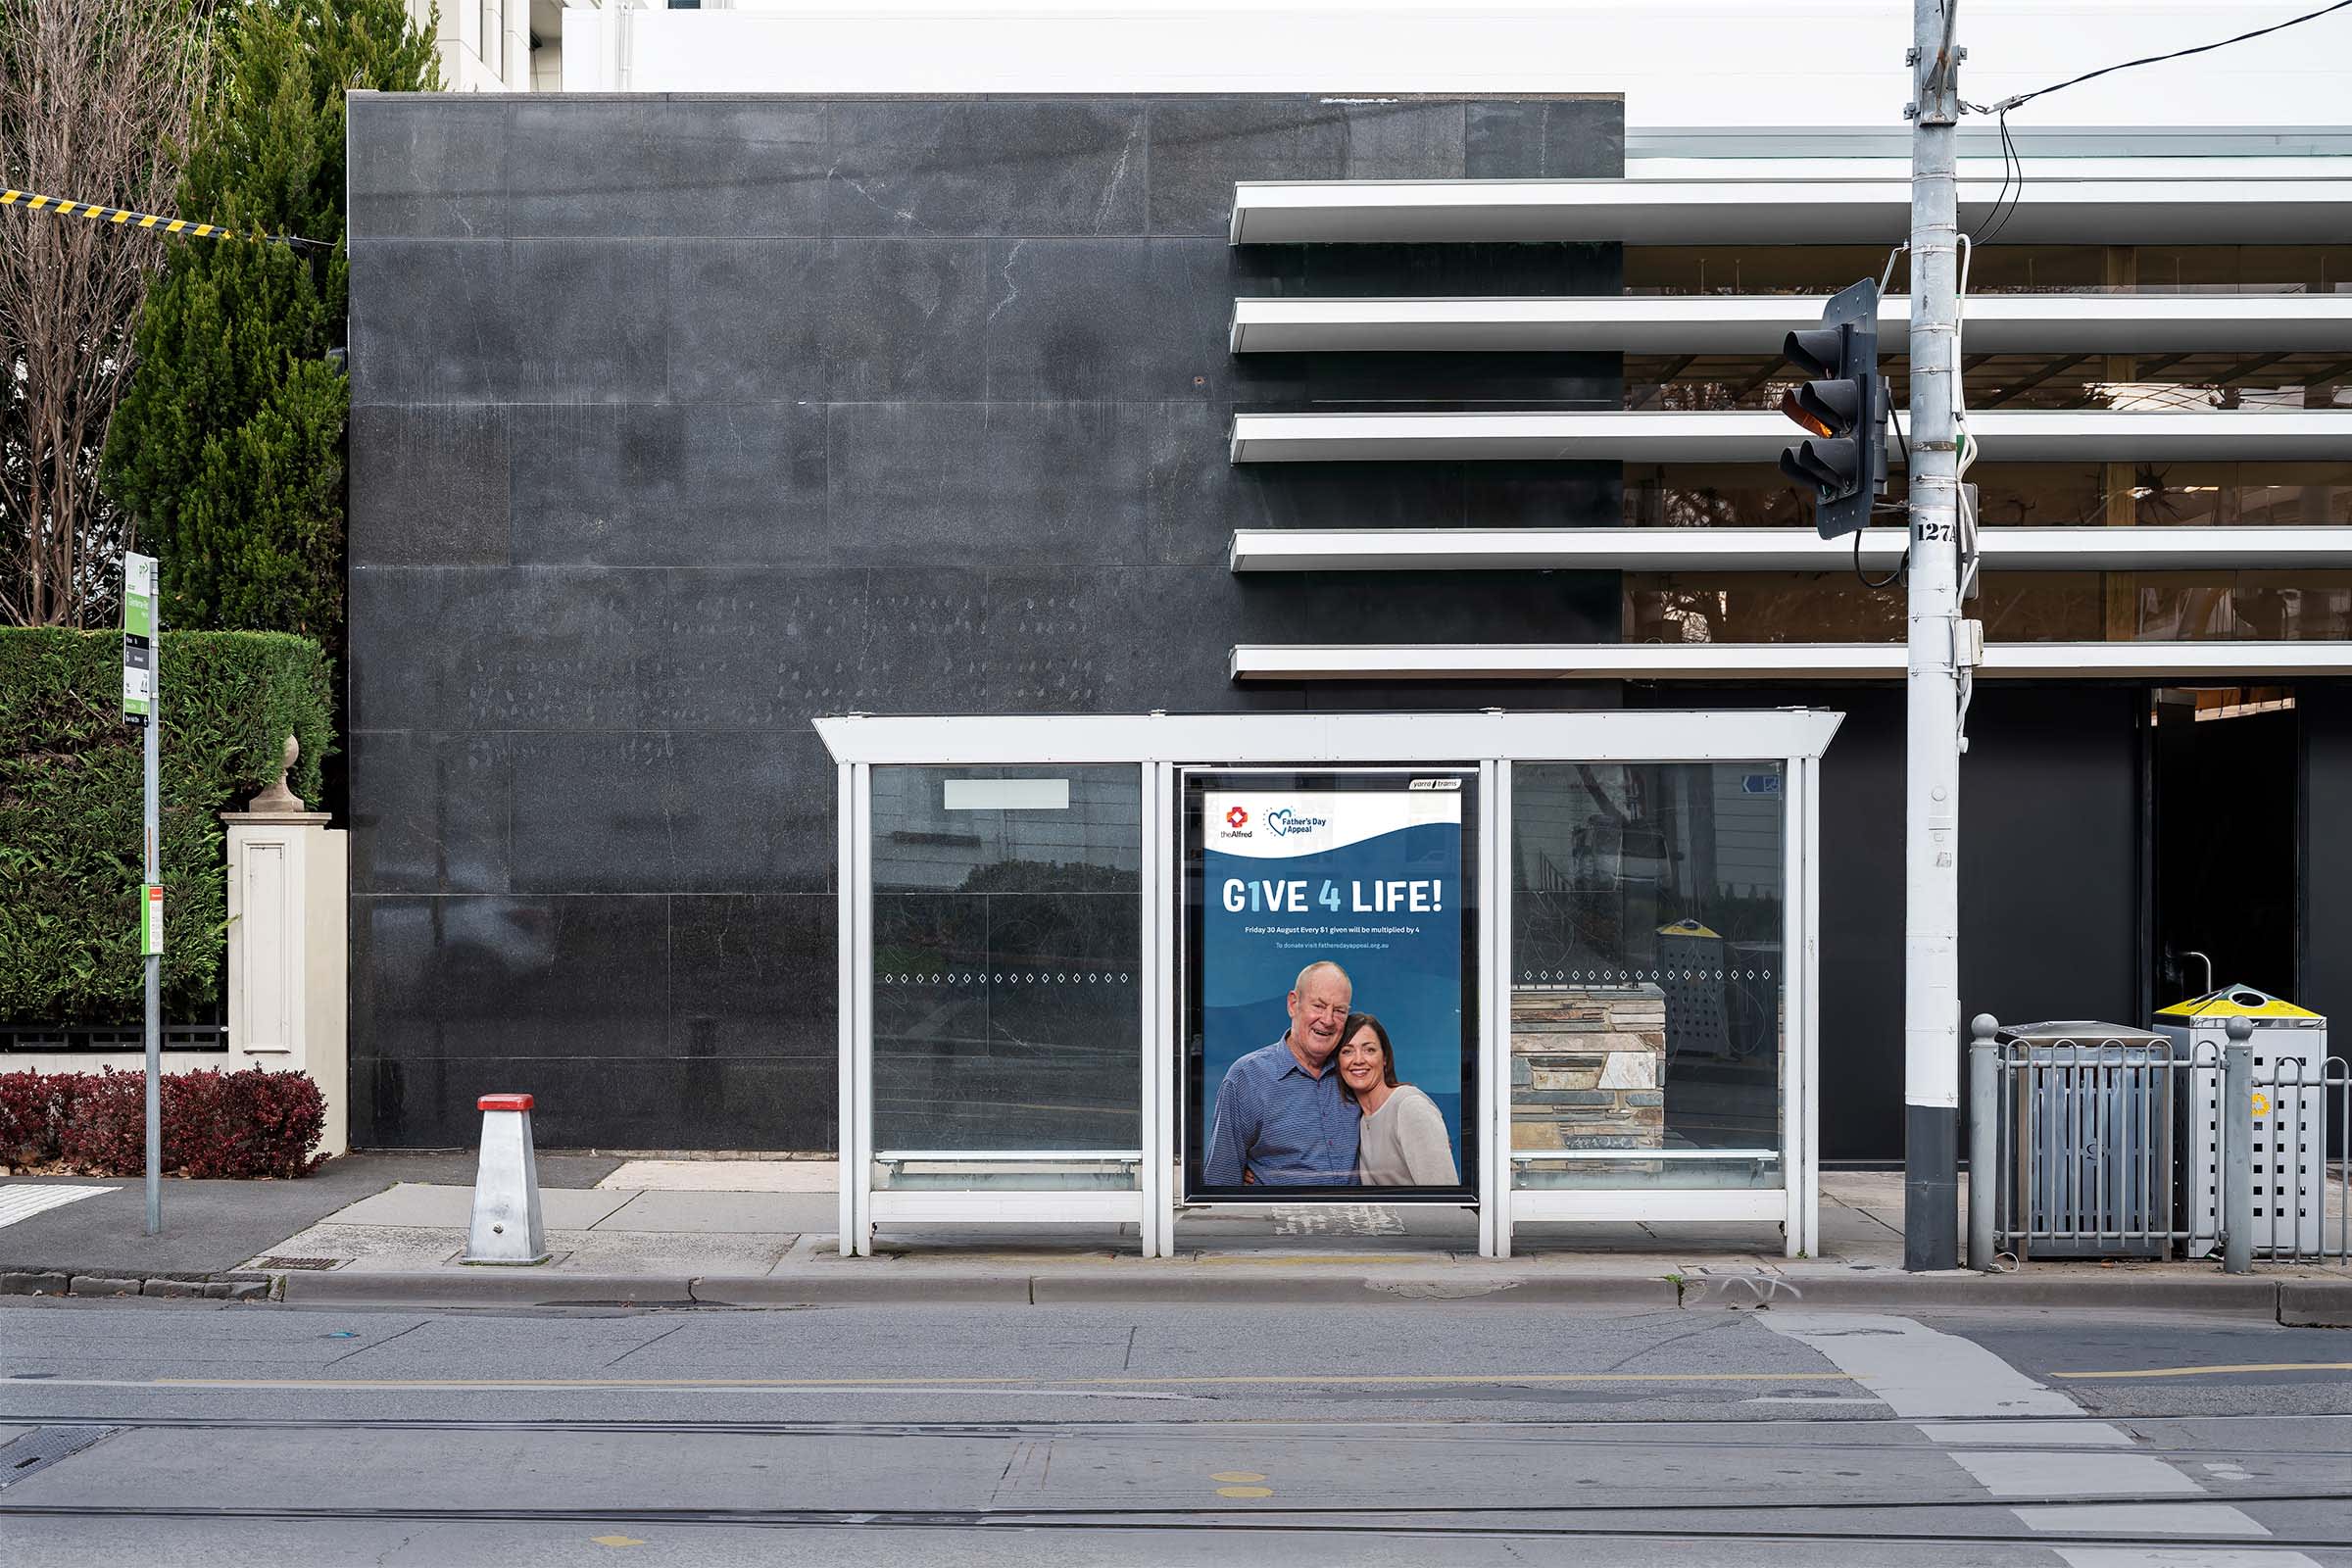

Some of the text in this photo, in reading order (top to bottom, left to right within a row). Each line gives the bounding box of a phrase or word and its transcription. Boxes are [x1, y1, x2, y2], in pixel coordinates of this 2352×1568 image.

[1312, 817, 1327, 826] Day
[1287, 825, 1312, 834] Appeal
[1223, 878, 1443, 912] G1VE 4 LIFE!
[1245, 926, 1266, 935] Friday
[1276, 926, 1299, 935] August
[1300, 926, 1319, 935] Every
[1330, 926, 1348, 935] given
[1371, 926, 1405, 935] multiplied
[1405, 926, 1415, 935] by
